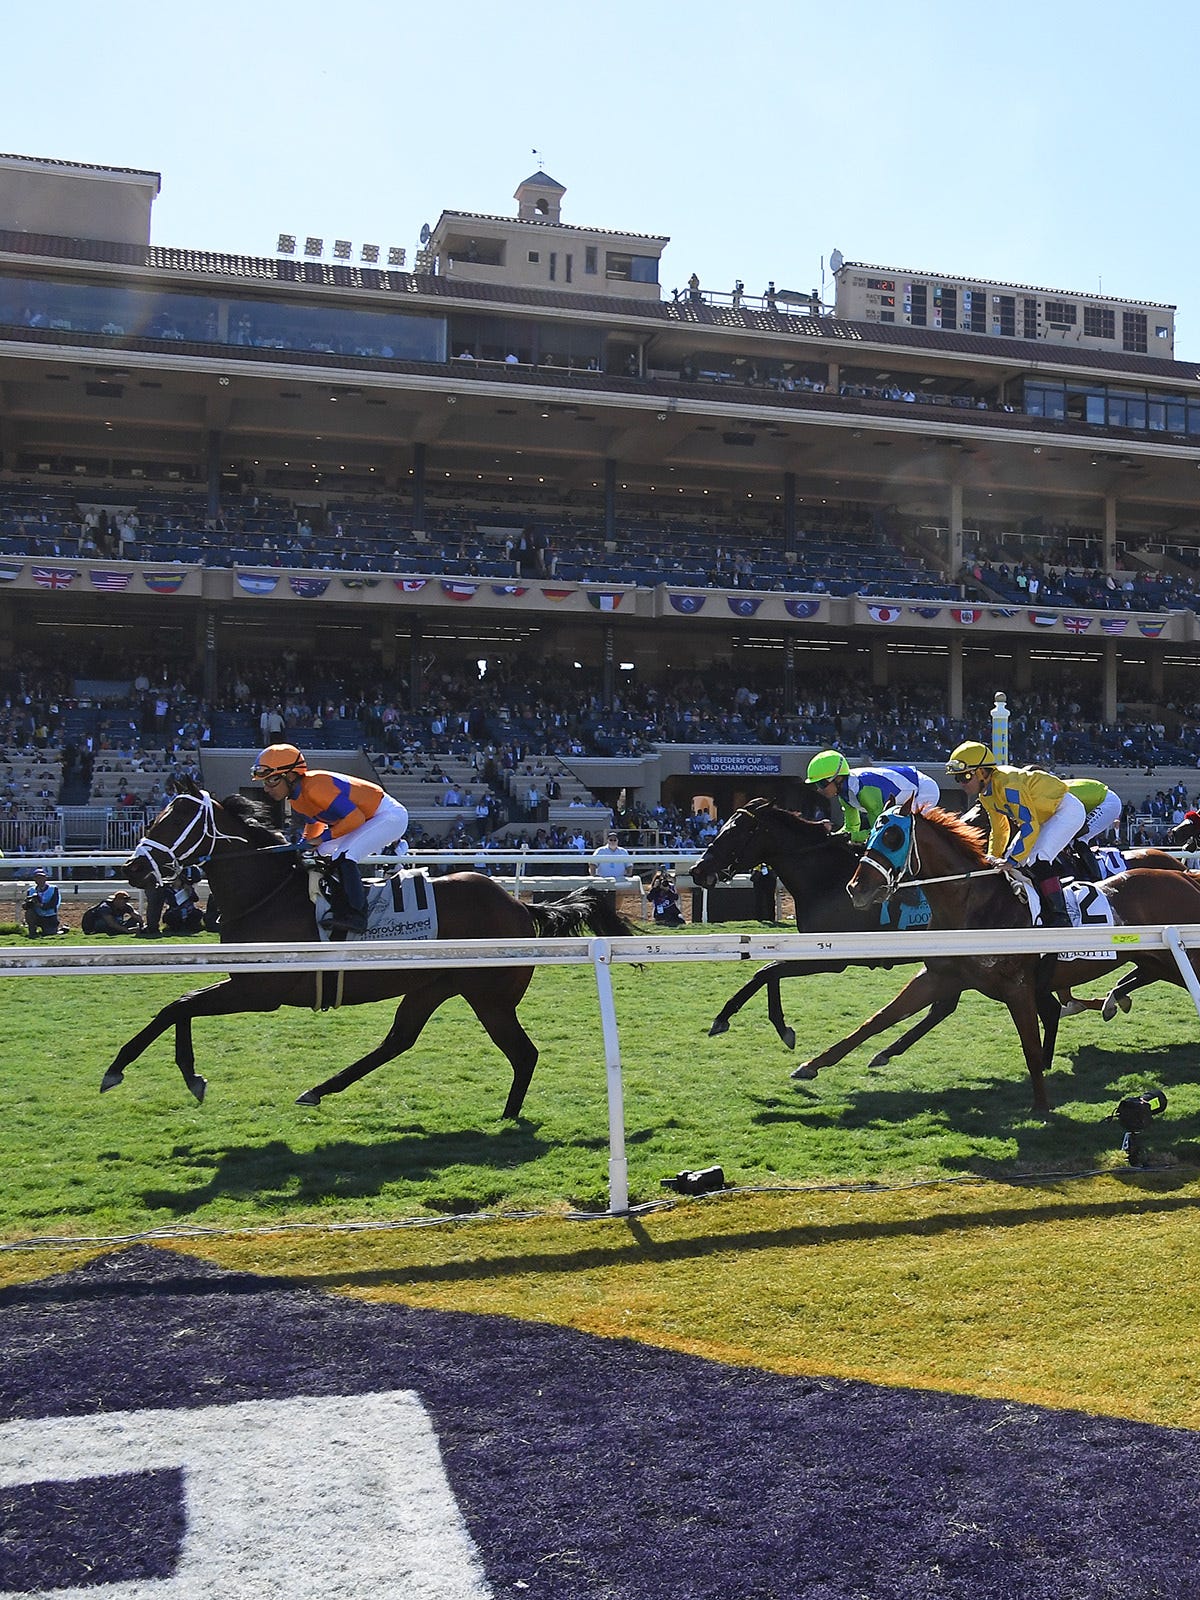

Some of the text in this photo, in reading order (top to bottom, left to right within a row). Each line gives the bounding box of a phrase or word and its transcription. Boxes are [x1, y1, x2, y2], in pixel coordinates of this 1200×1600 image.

[911, 279, 963, 290] APPROXIMATE
[710, 756, 747, 764] BREEDERS'
[720, 764, 779, 772] CHAMPIONSHIPS
[390, 874, 429, 913] 11
[1070, 882, 1109, 925] 2
[361, 917, 431, 936] horoughbred
[646, 945, 661, 953] 35
[817, 942, 832, 950] 34
